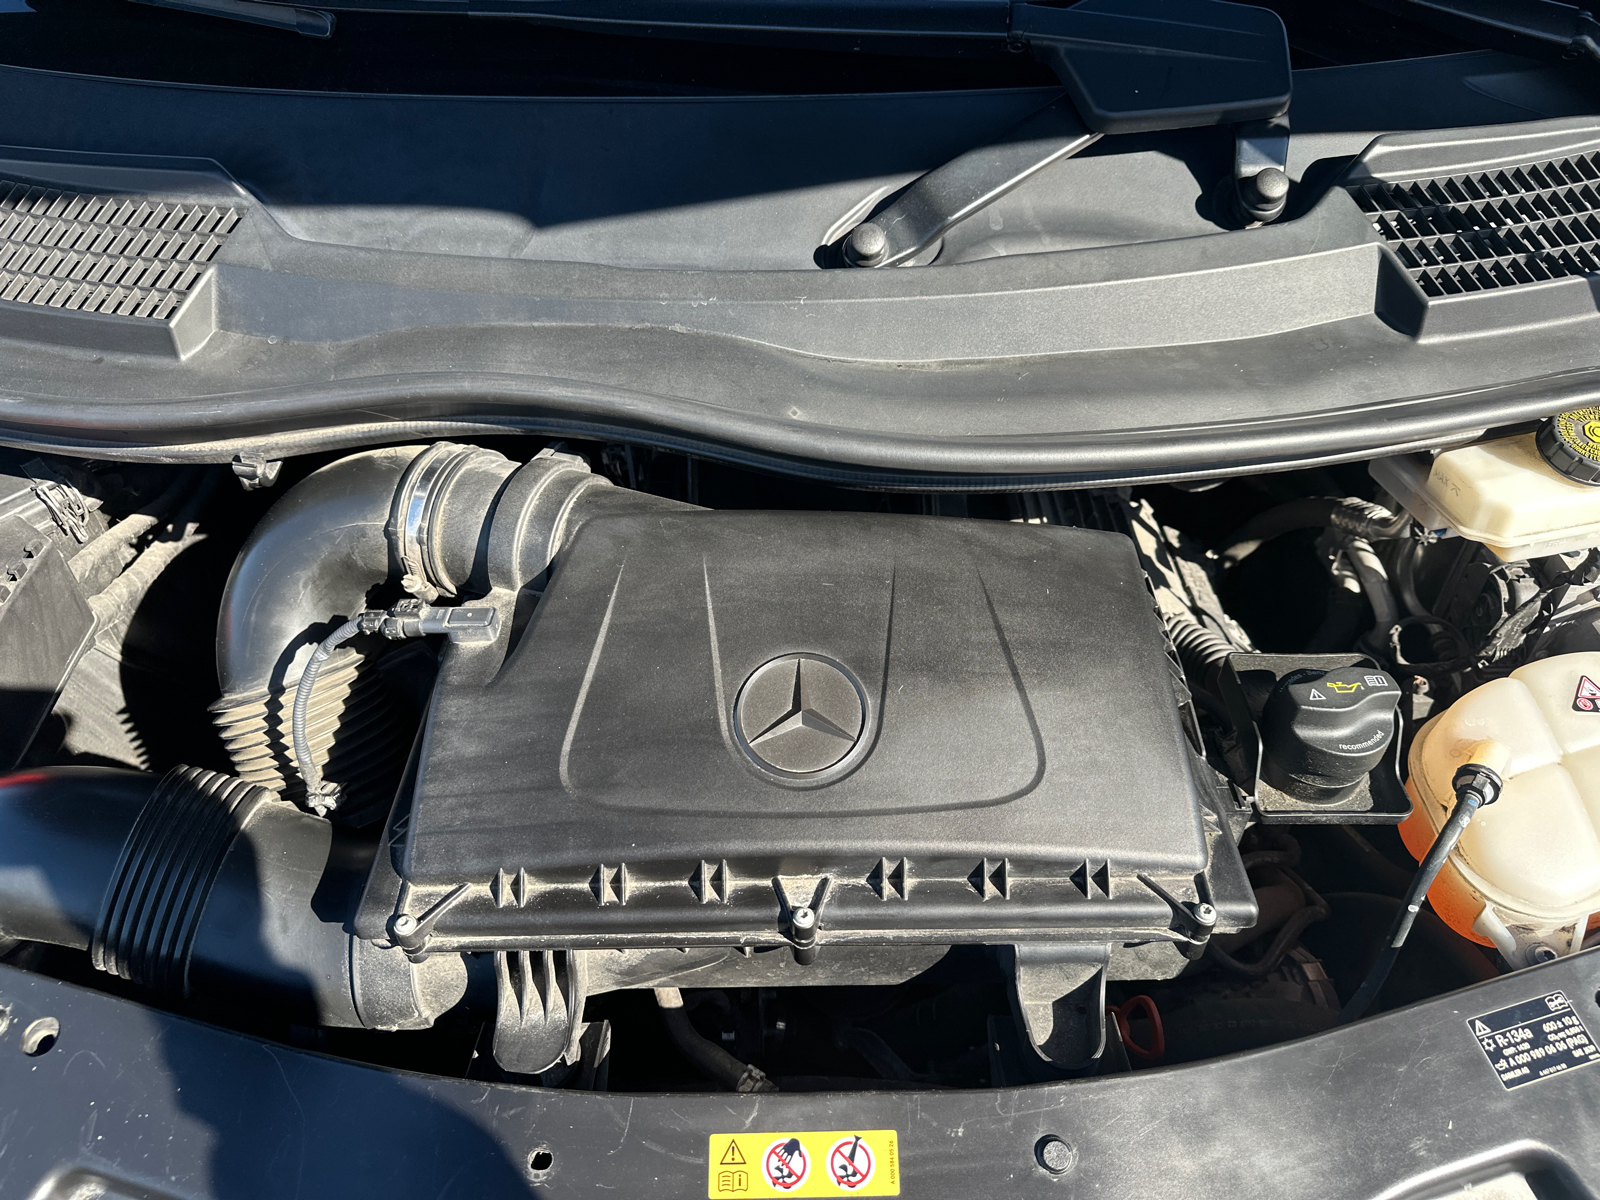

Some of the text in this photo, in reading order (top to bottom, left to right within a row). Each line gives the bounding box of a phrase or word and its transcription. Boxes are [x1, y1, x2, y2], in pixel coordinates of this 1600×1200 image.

[1338, 729, 1385, 750] recommended
[1542, 1021, 1558, 1033] 600
[1562, 1016, 1573, 1026] 10
[1495, 1028, 1534, 1047] R-134a
[1508, 1033, 1589, 1067] A 000 989 06 06 (PAG)
